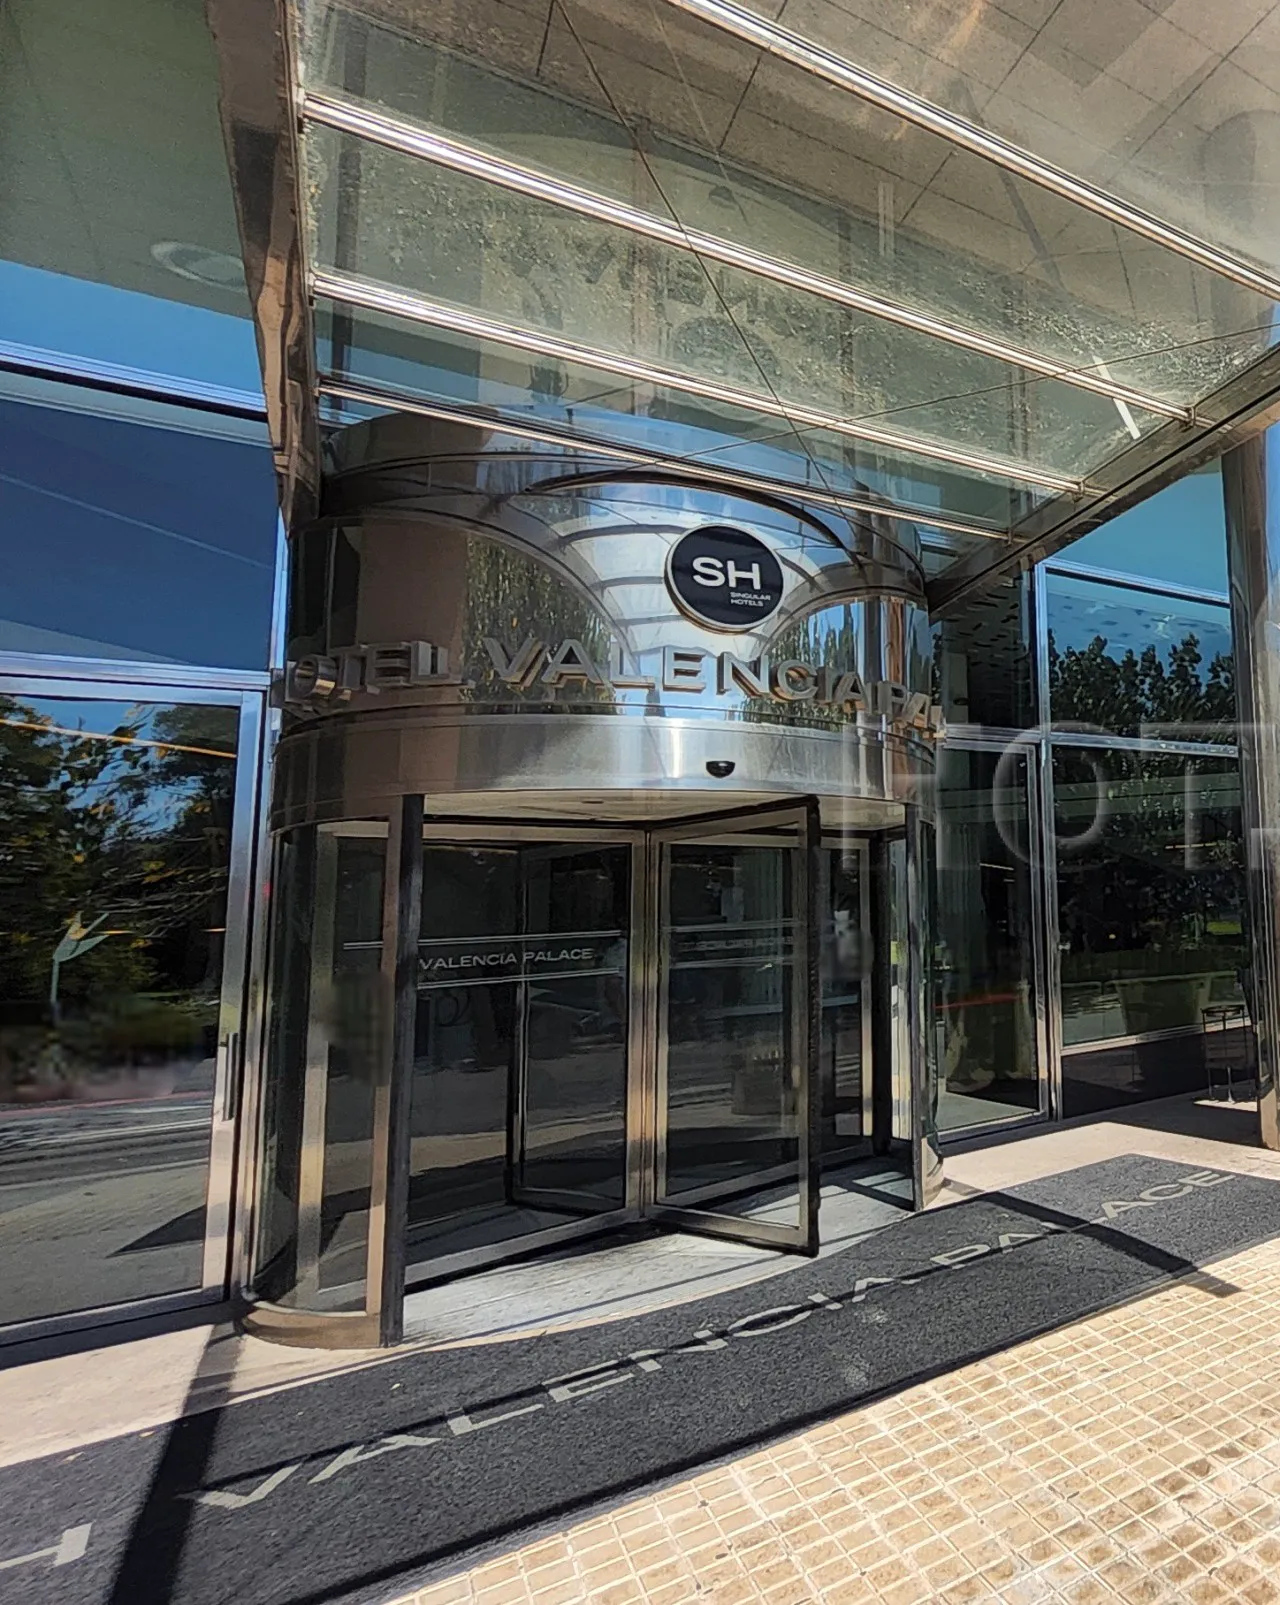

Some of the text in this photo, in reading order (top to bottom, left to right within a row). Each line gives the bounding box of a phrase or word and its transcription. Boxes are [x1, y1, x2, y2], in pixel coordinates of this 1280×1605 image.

[692, 556, 762, 590] SH
[729, 591, 771, 601] SINGULAR
[730, 598, 764, 607] HOTELS
[286, 640, 470, 699] OTEL
[483, 637, 873, 715] VALENCIA
[418, 947, 595, 971] VALENCIA PALACE
